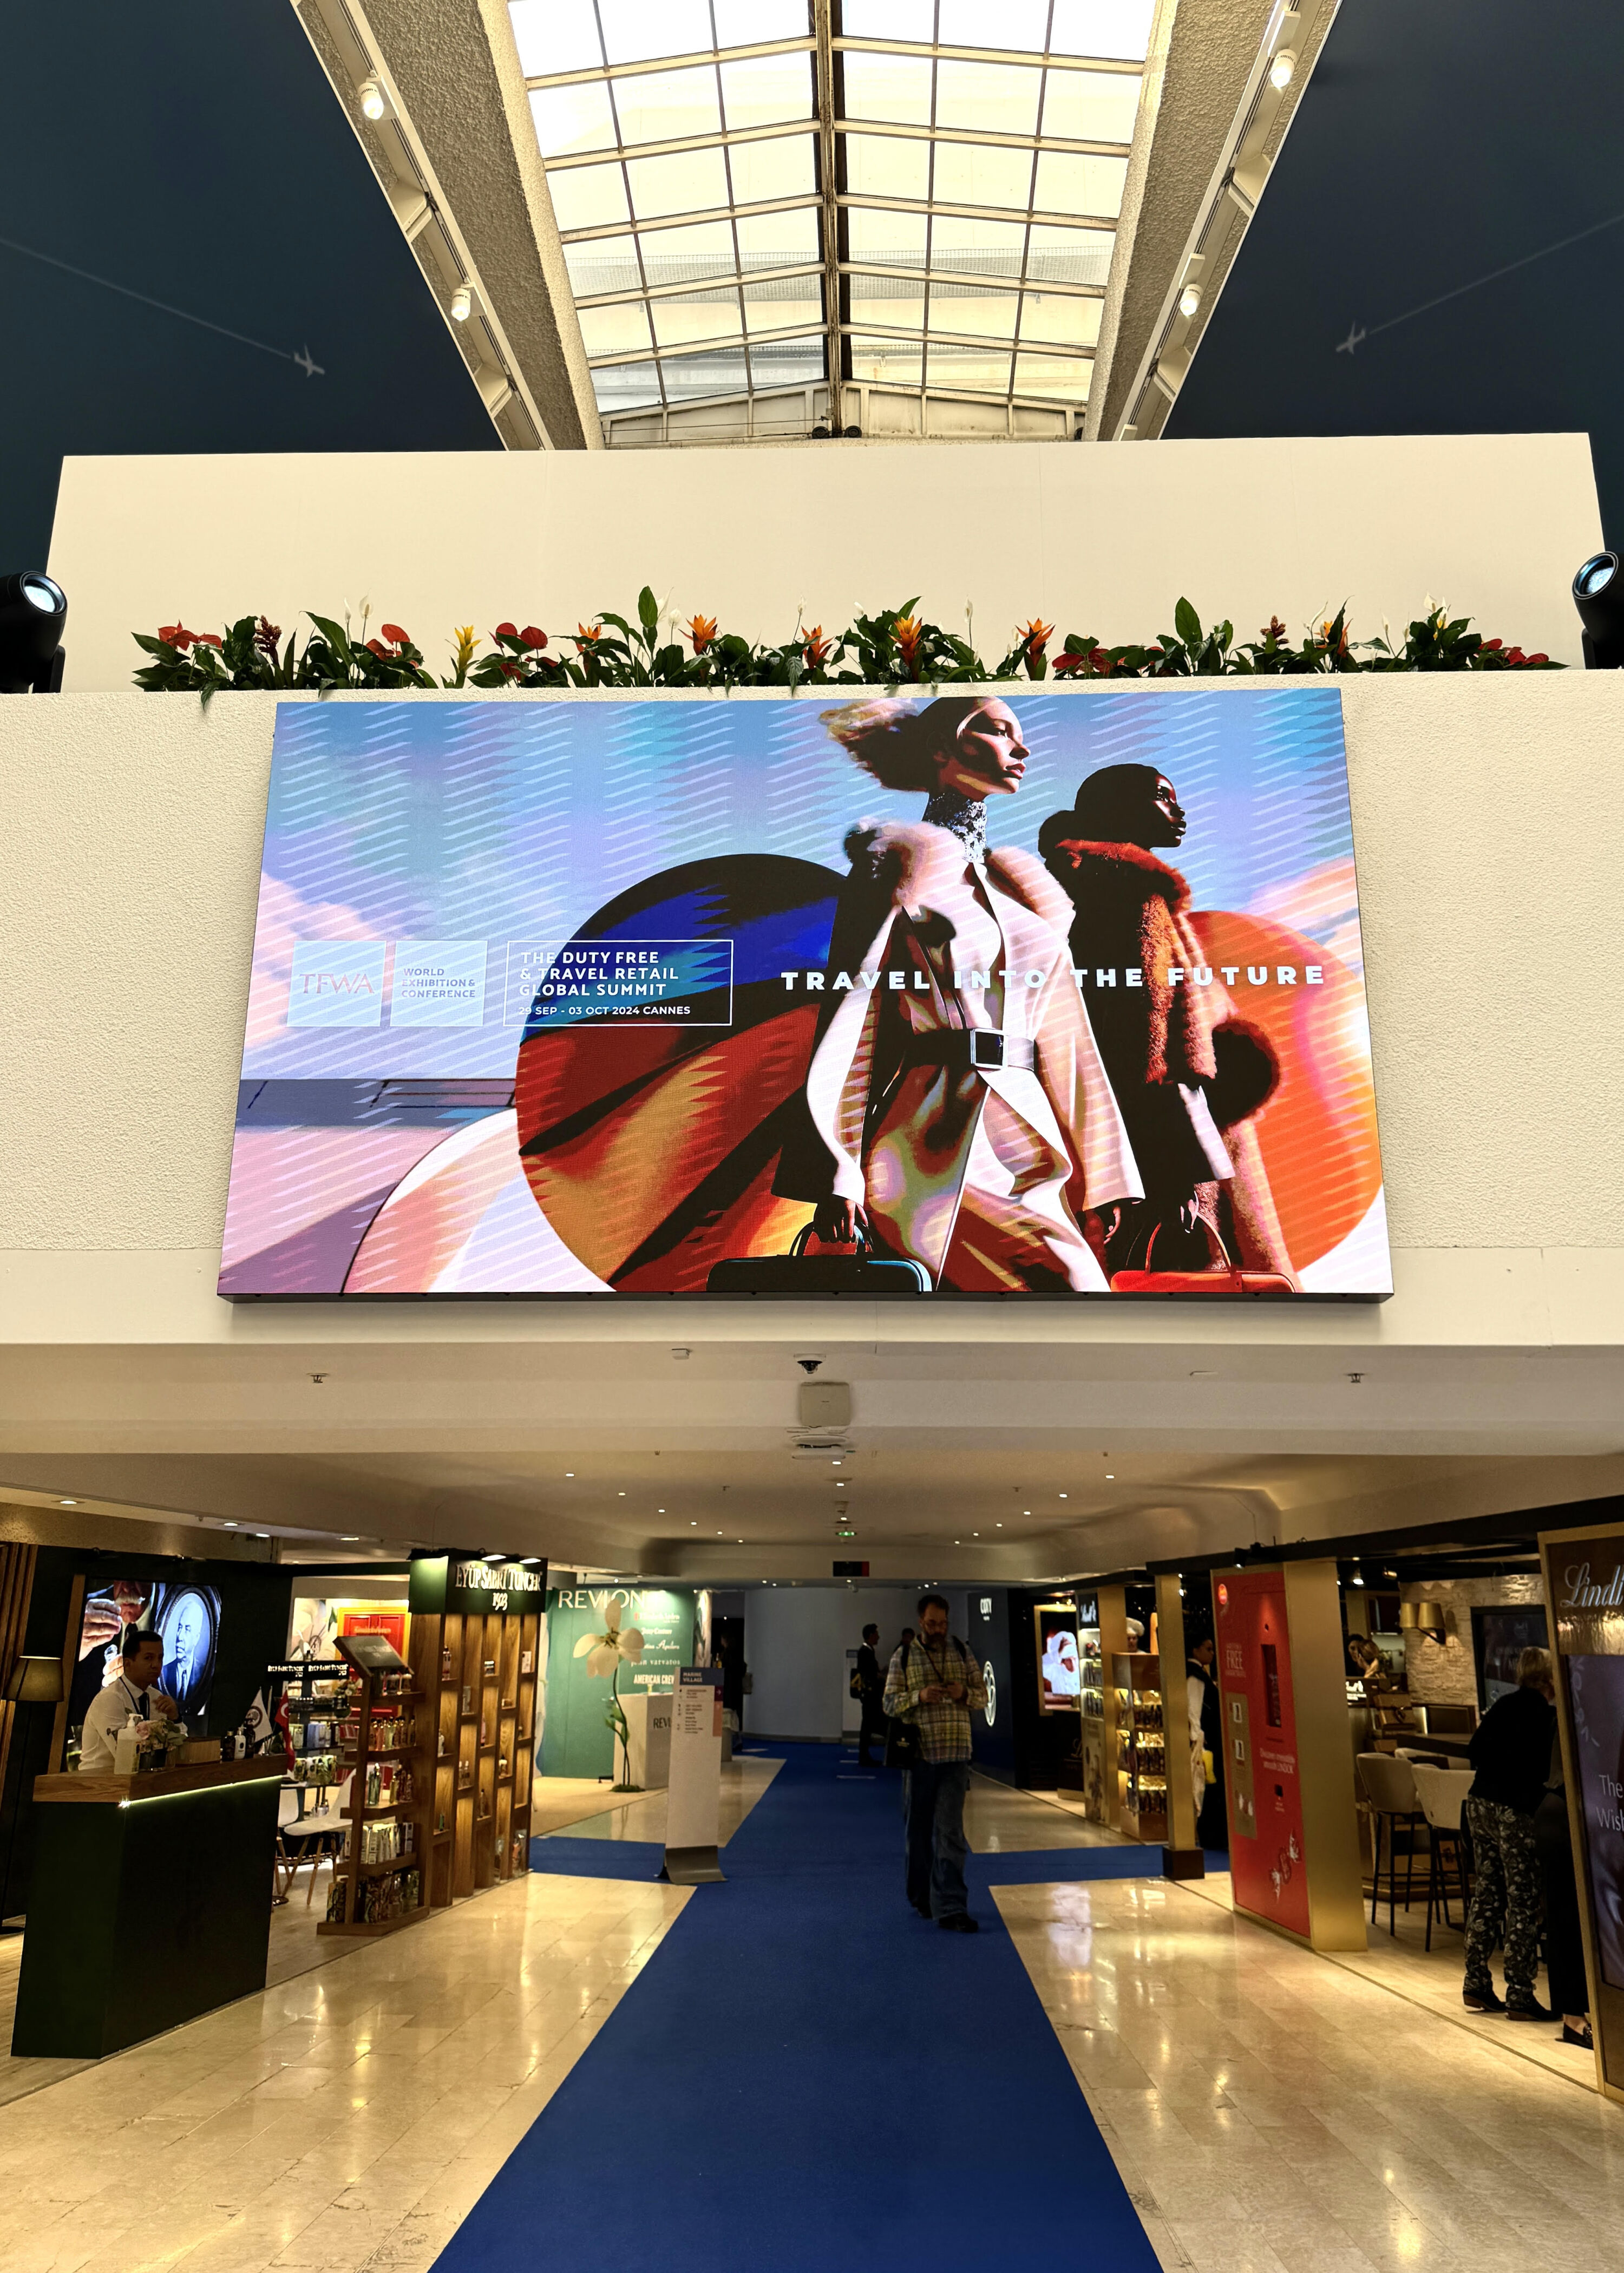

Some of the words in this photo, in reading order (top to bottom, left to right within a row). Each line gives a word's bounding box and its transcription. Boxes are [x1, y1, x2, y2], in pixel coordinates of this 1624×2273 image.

[521, 952, 556, 964] THE
[562, 951, 611, 964] DUTY
[615, 951, 659, 964] FREE
[403, 968, 444, 976] WORLD
[520, 968, 531, 980] &
[538, 967, 608, 980] TRAVEL
[615, 967, 678, 980] RETAIL
[781, 971, 930, 991] TRAVEL
[954, 969, 1046, 989] INTO
[1070, 968, 1143, 988] THE
[1167, 965, 1324, 987] FUTURE
[299, 973, 374, 994] TFWA
[519, 984, 591, 996] GLOBAL
[597, 983, 666, 996] SUMMIT
[402, 990, 476, 998] CONFERENCE
[518, 1006, 532, 1016] 29
[535, 1006, 558, 1016] SEP
[568, 1006, 582, 1016] 03
[585, 1006, 610, 1016] OCT
[612, 1006, 640, 1016] 2024
[643, 1006, 691, 1015] CANNES
[1560, 1562, 1624, 1608] Lindt
[1226, 1649, 1243, 1670] FREE
[1599, 1773, 1623, 1799] The
